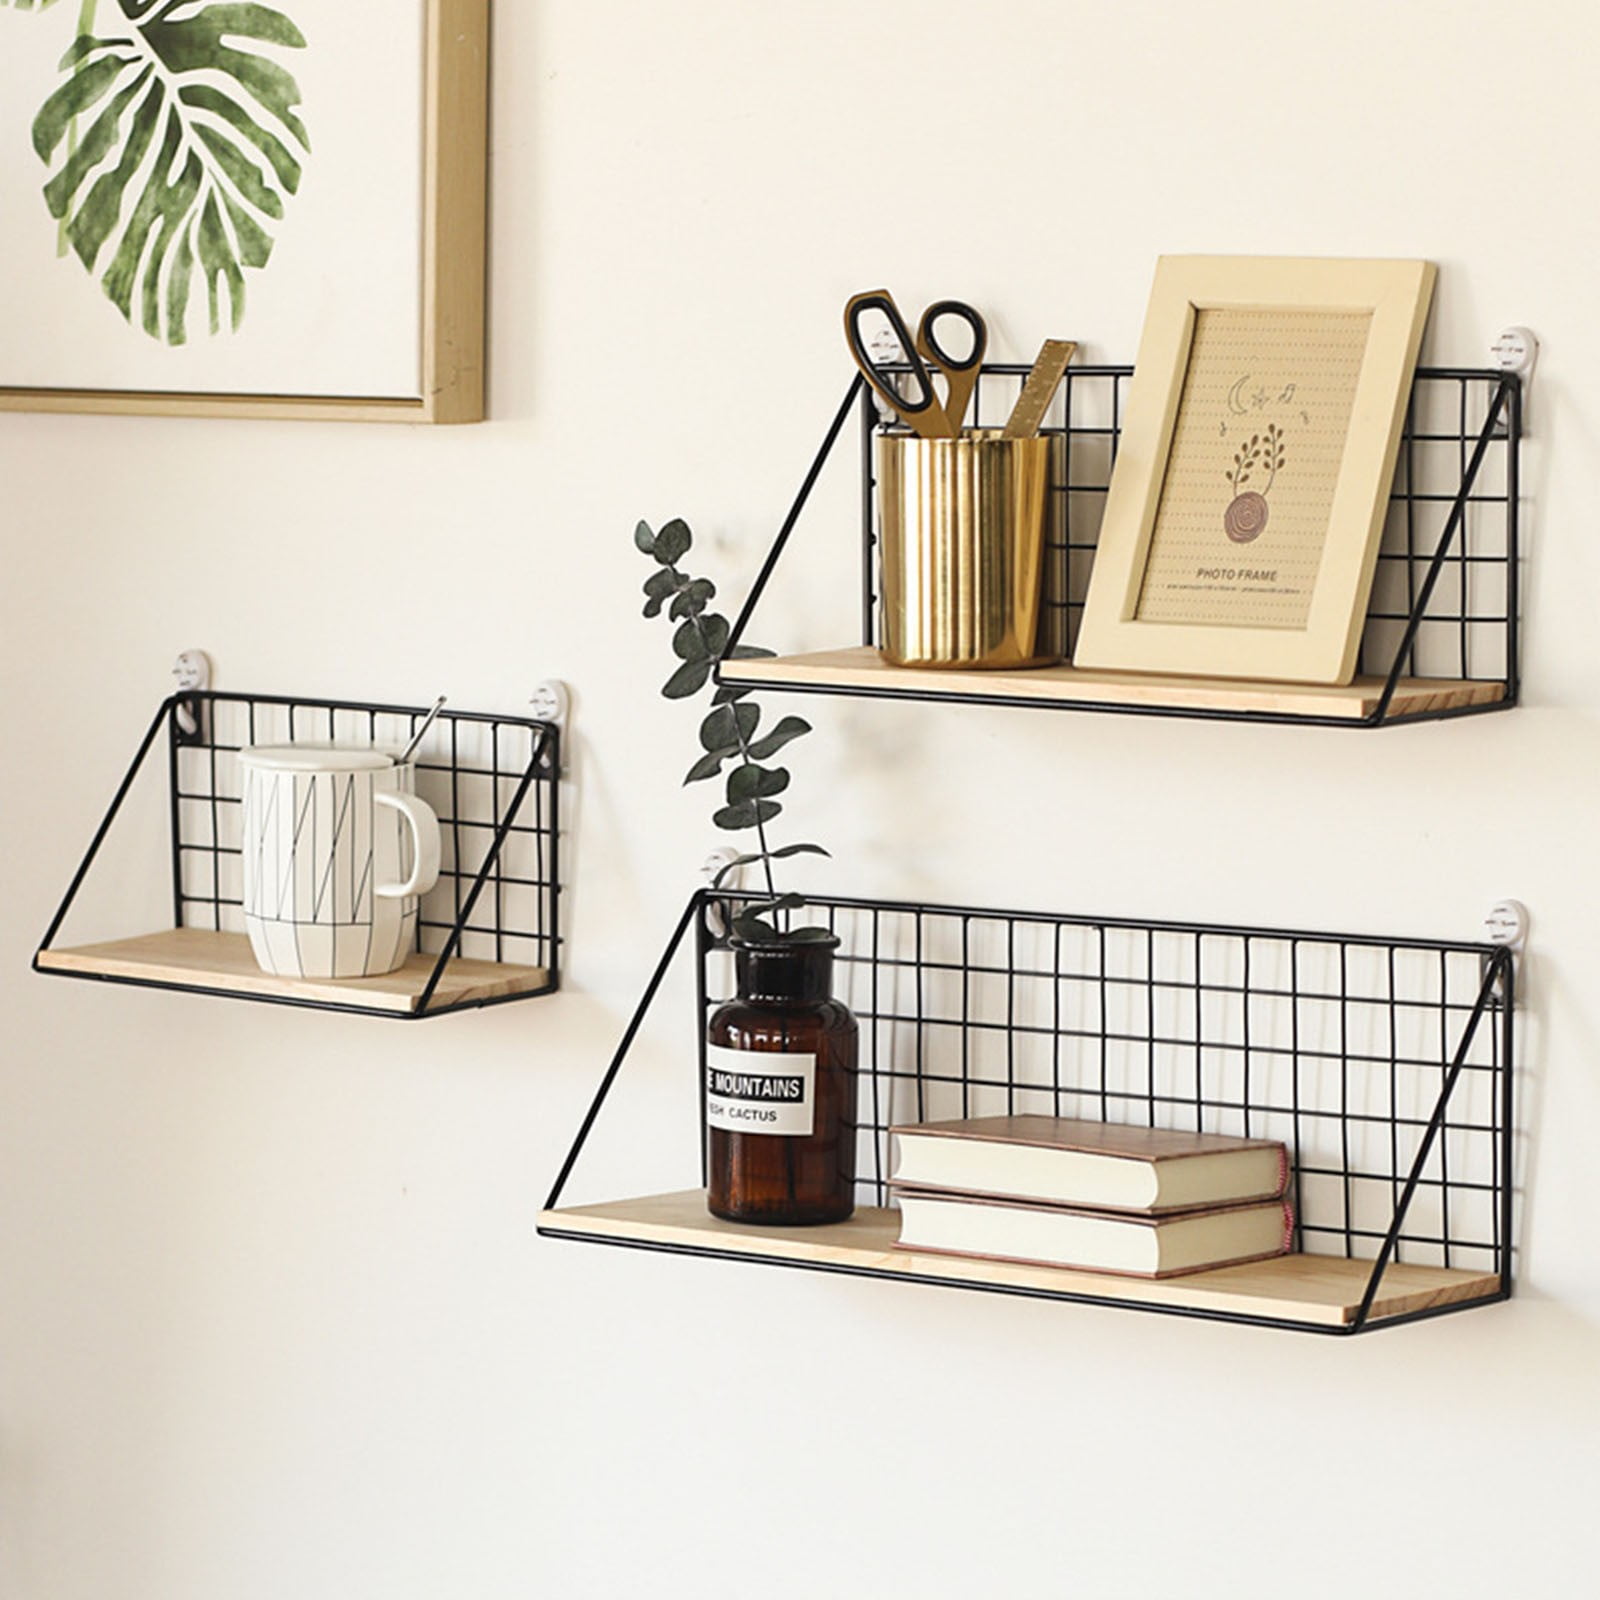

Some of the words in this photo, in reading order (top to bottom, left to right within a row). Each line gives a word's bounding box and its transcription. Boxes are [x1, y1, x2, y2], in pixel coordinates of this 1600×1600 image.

[1196, 567, 1236, 580] PHOTO
[1237, 568, 1278, 582] FRAME
[715, 1072, 800, 1098] MOUNTAINS
[729, 1106, 778, 1122] CACTUS
